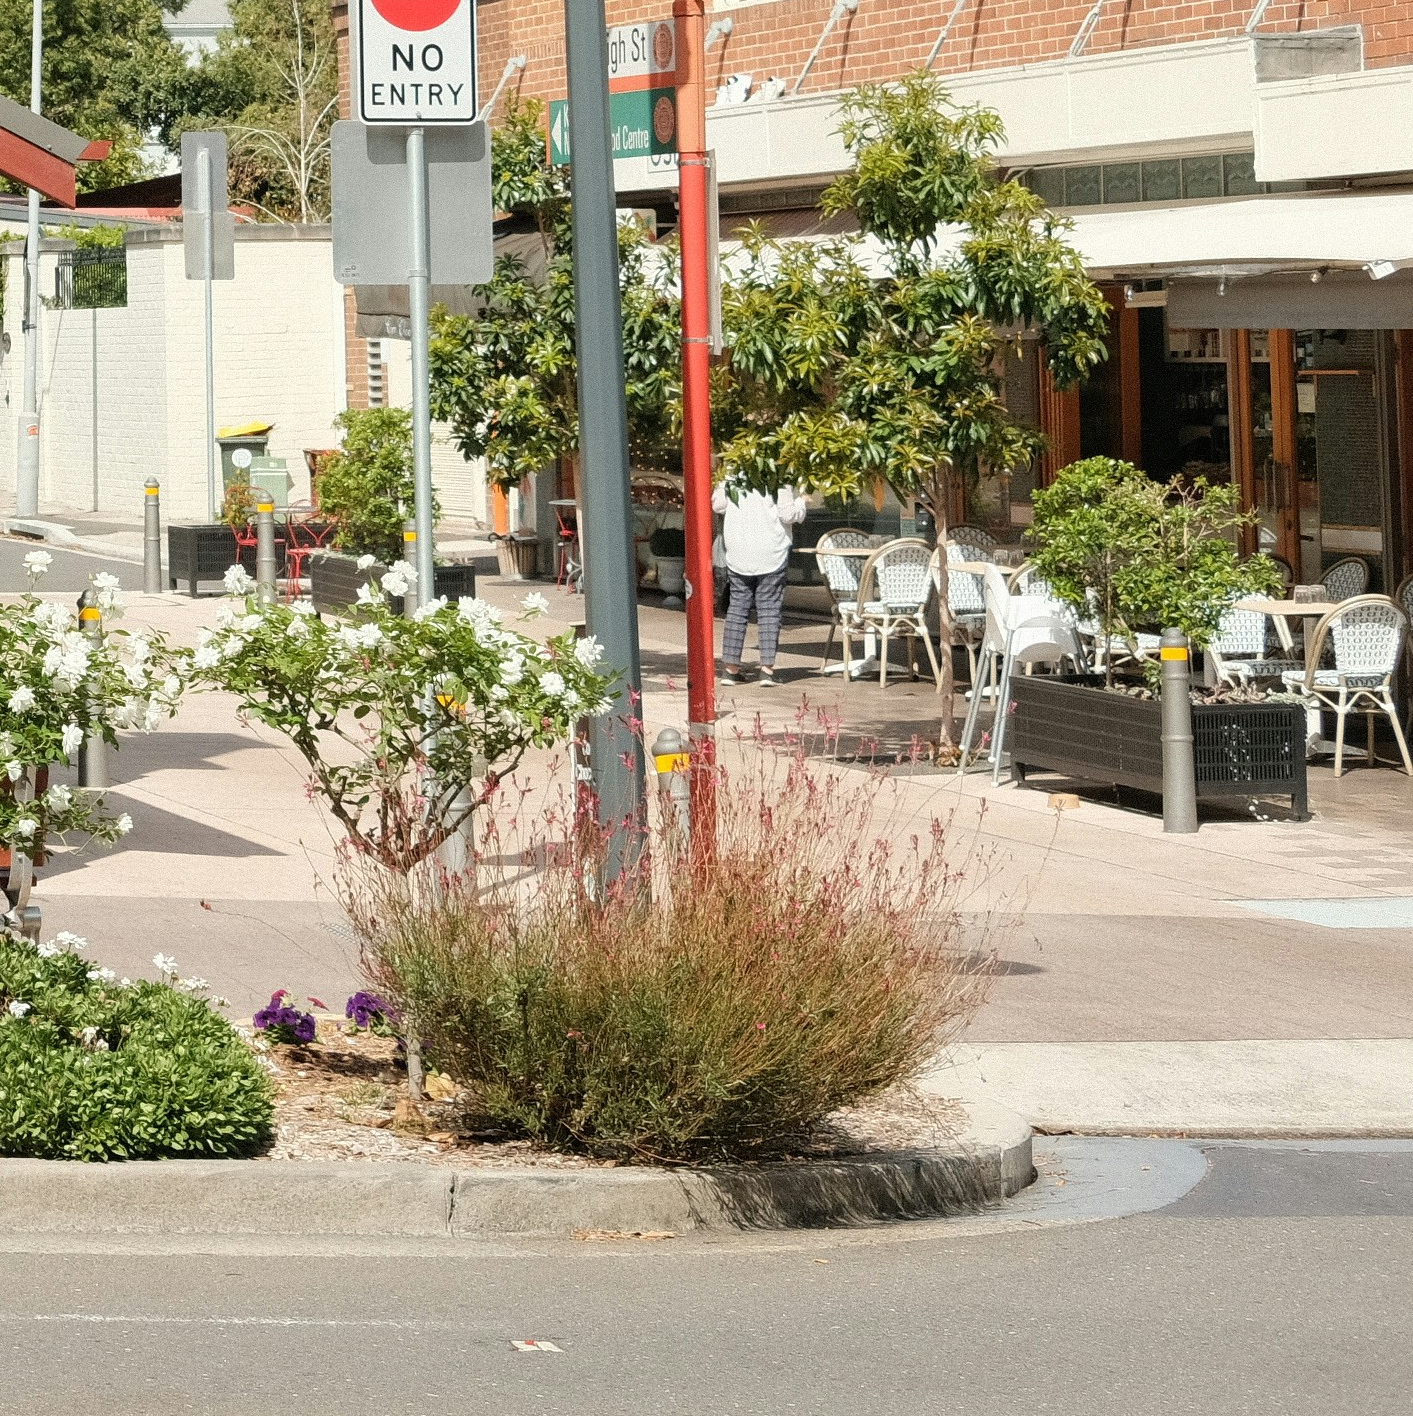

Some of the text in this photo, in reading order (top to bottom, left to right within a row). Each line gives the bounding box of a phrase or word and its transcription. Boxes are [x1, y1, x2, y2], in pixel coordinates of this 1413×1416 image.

[391, 43, 443, 72] NO
[631, 28, 646, 62] St
[371, 83, 464, 106] ENTRY
[622, 125, 649, 150] Centre
